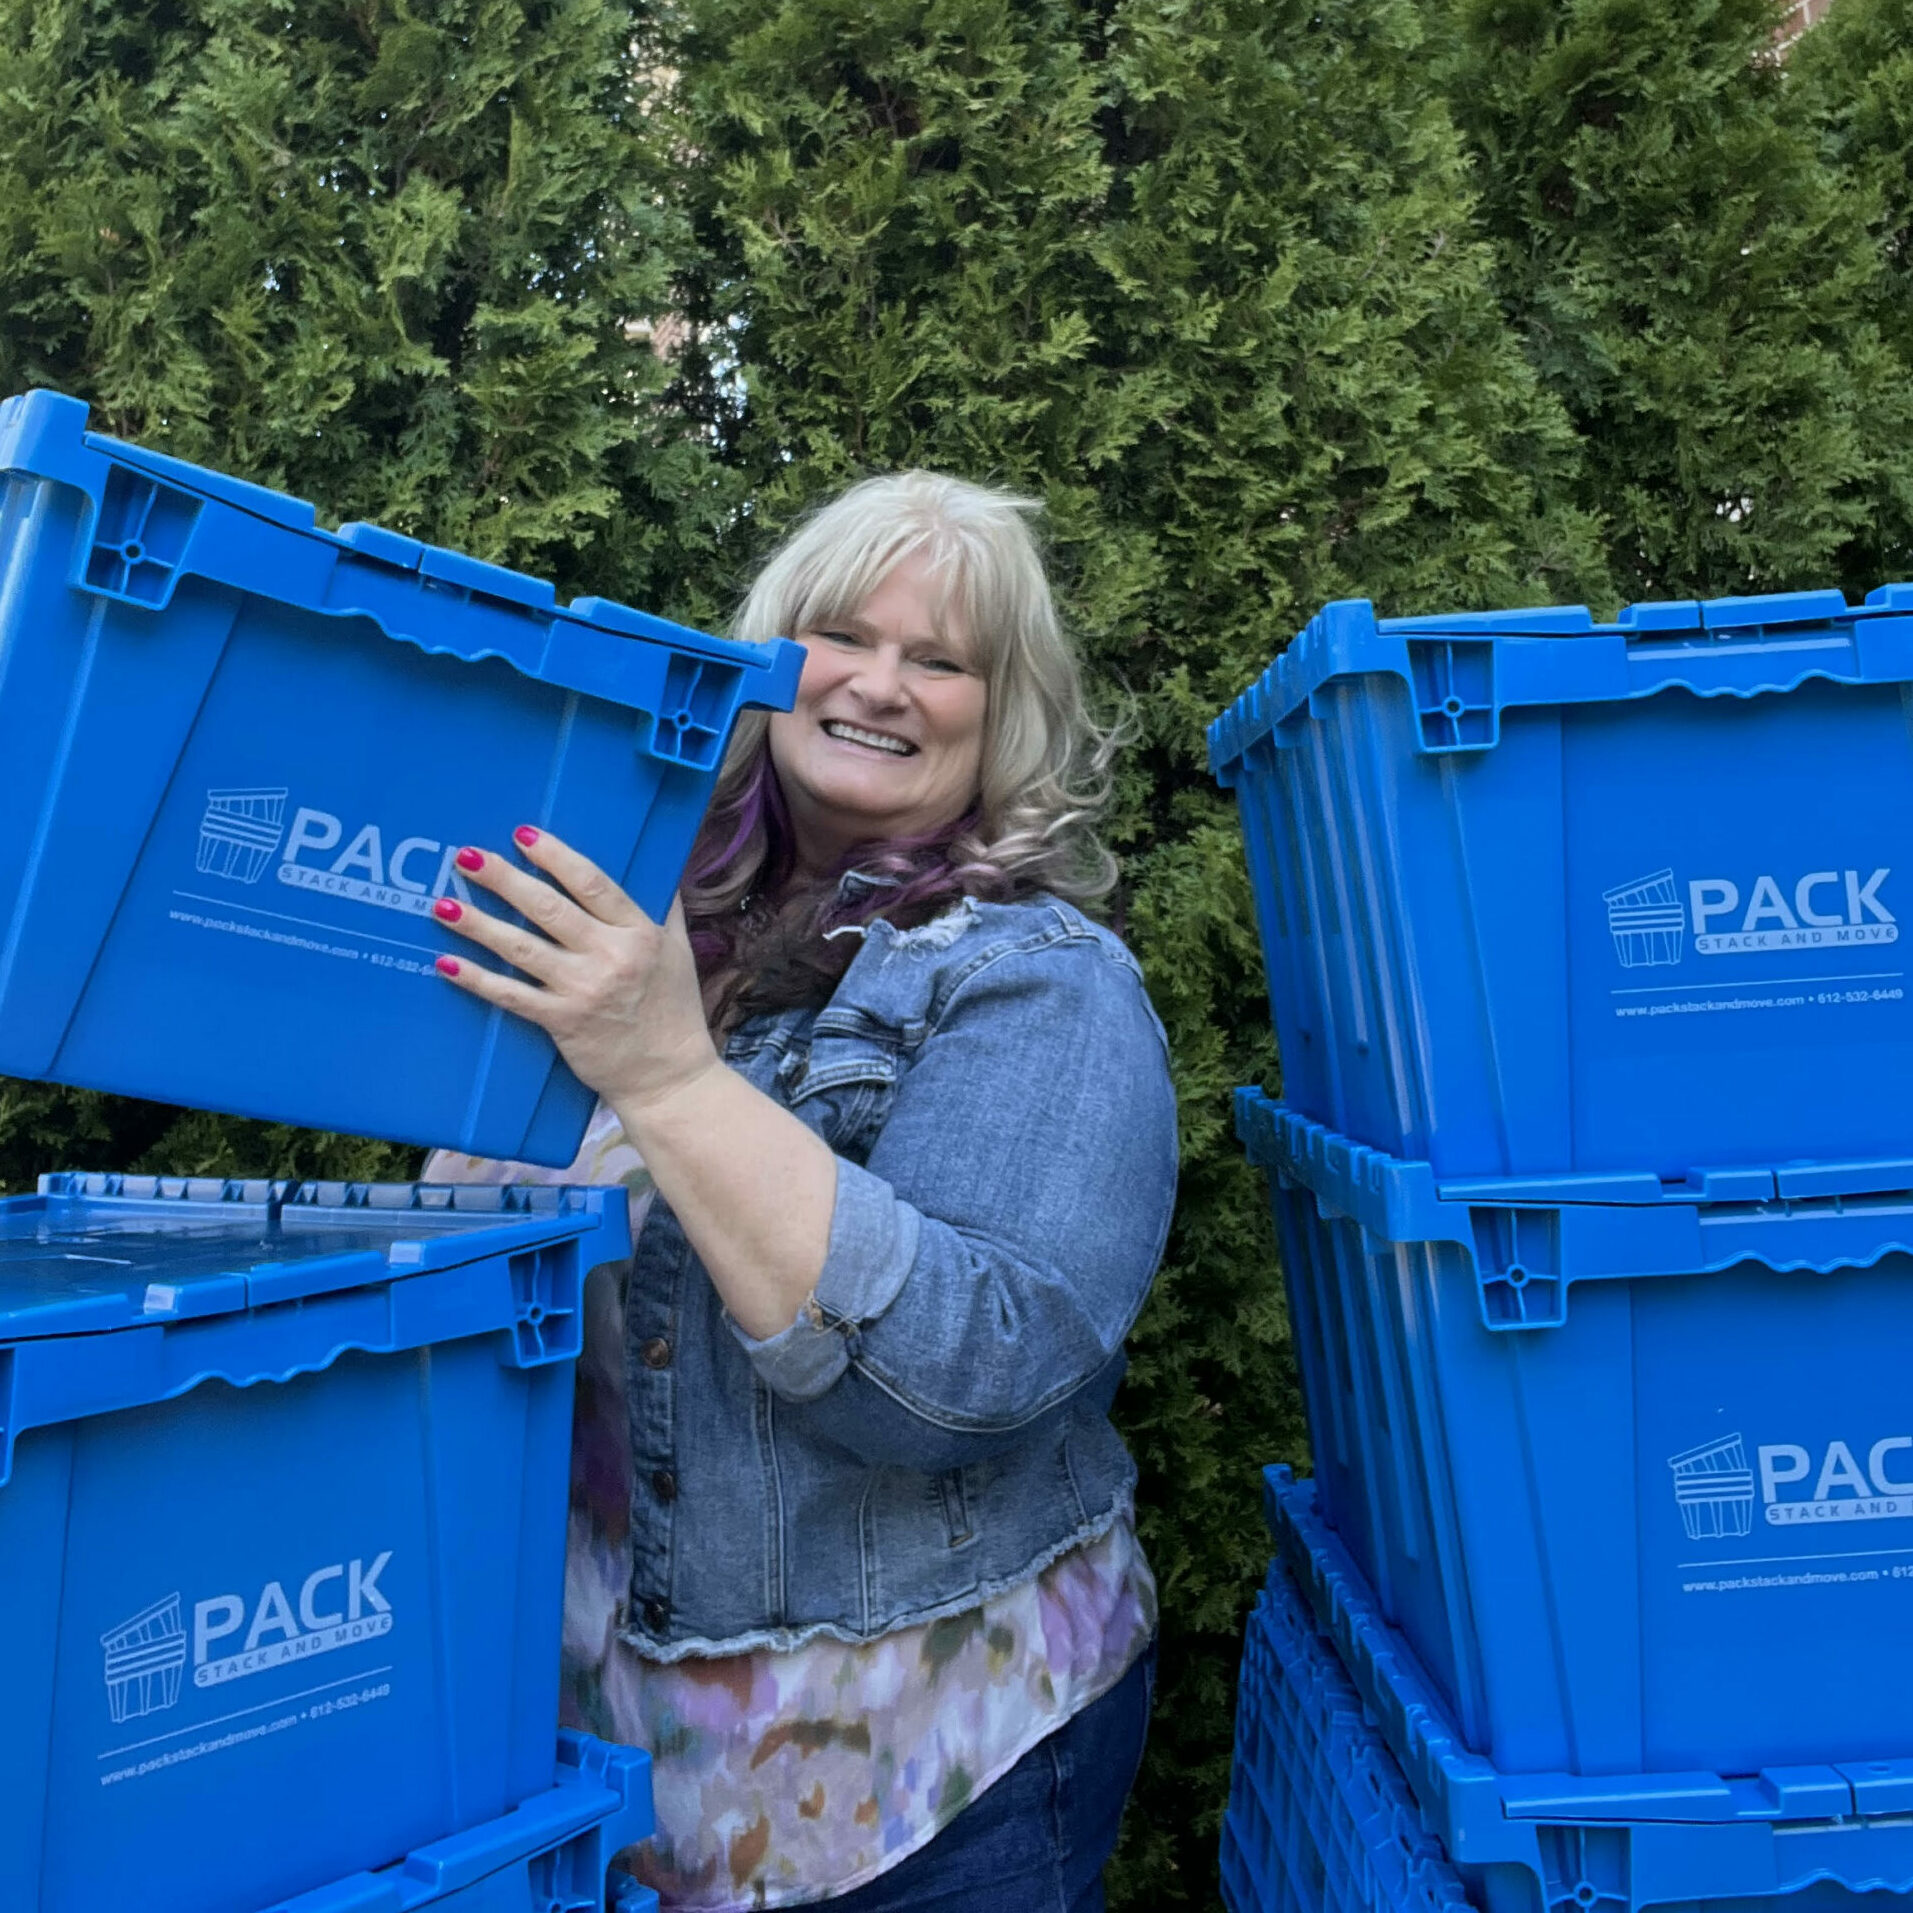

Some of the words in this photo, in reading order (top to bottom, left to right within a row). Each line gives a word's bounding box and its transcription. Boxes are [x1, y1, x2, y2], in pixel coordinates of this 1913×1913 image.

[282, 807, 473, 903] PACK
[281, 866, 350, 893] STACK
[359, 886, 402, 905] AND
[1689, 868, 1897, 935] PACK
[169, 908, 359, 960] www.packstackandmove.com
[1699, 934, 1767, 951] STACK
[1780, 932, 1823, 946] AND
[1837, 926, 1896, 942] MOVE
[1615, 995, 1804, 1017] www.packstackandmove.com
[1758, 1436, 1913, 1503] PAC
[1769, 1502, 1841, 1521] STACK
[1854, 1501, 1898, 1516] AND
[194, 1551, 394, 1666] PACK
[1683, 1570, 1879, 1593] www.packstackandmove.com
[197, 1649, 269, 1684] STACK
[280, 1636, 323, 1659] AND
[335, 1616, 391, 1645] MOVE
[101, 1715, 298, 1787] www.packstackandmove.com
